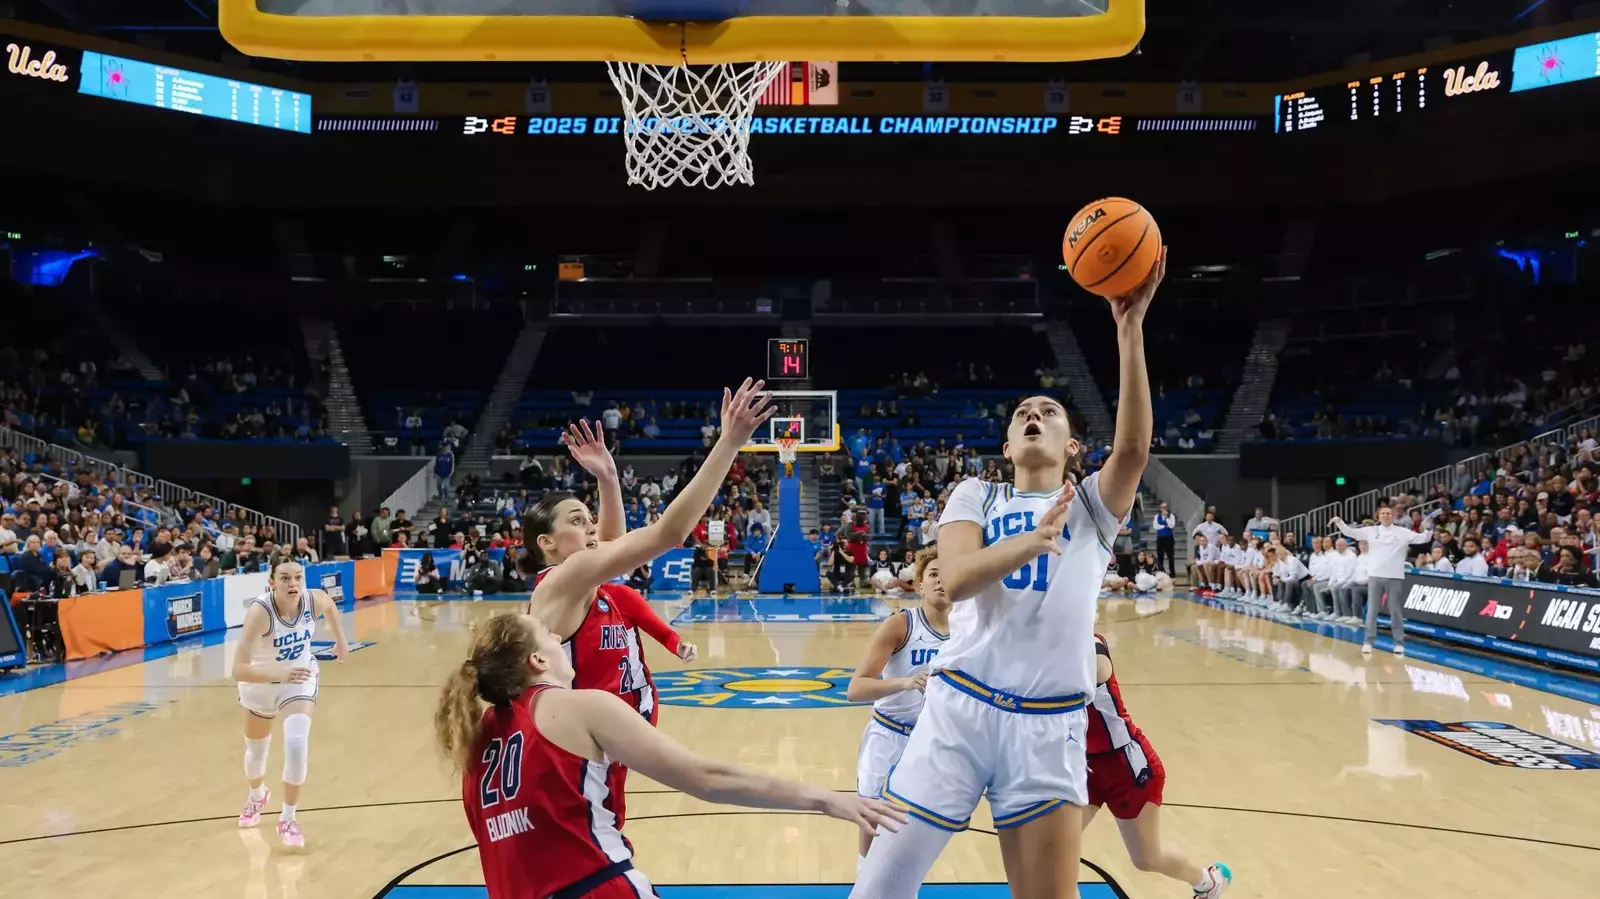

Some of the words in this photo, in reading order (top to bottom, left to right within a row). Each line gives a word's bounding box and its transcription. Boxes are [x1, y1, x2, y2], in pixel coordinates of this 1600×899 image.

[6, 43, 69, 82] Ucla
[1443, 61, 1500, 97] Ucla
[528, 117, 587, 134] 2025
[594, 117, 619, 134] DI
[879, 117, 1057, 134] CHAMPIONSHIP
[1068, 208, 1107, 248] NCAA
[779, 343, 803, 353] 9:11
[783, 356, 800, 374] 14
[984, 511, 1071, 546] UCL
[1403, 583, 1471, 618] RICHMOND
[1540, 598, 1588, 630] NCAA
[273, 629, 311, 648] UCLA
[275, 644, 305, 662] 32
[911, 648, 939, 666] UC
[481, 730, 525, 809] 20
[486, 807, 535, 843] BUDNIK
